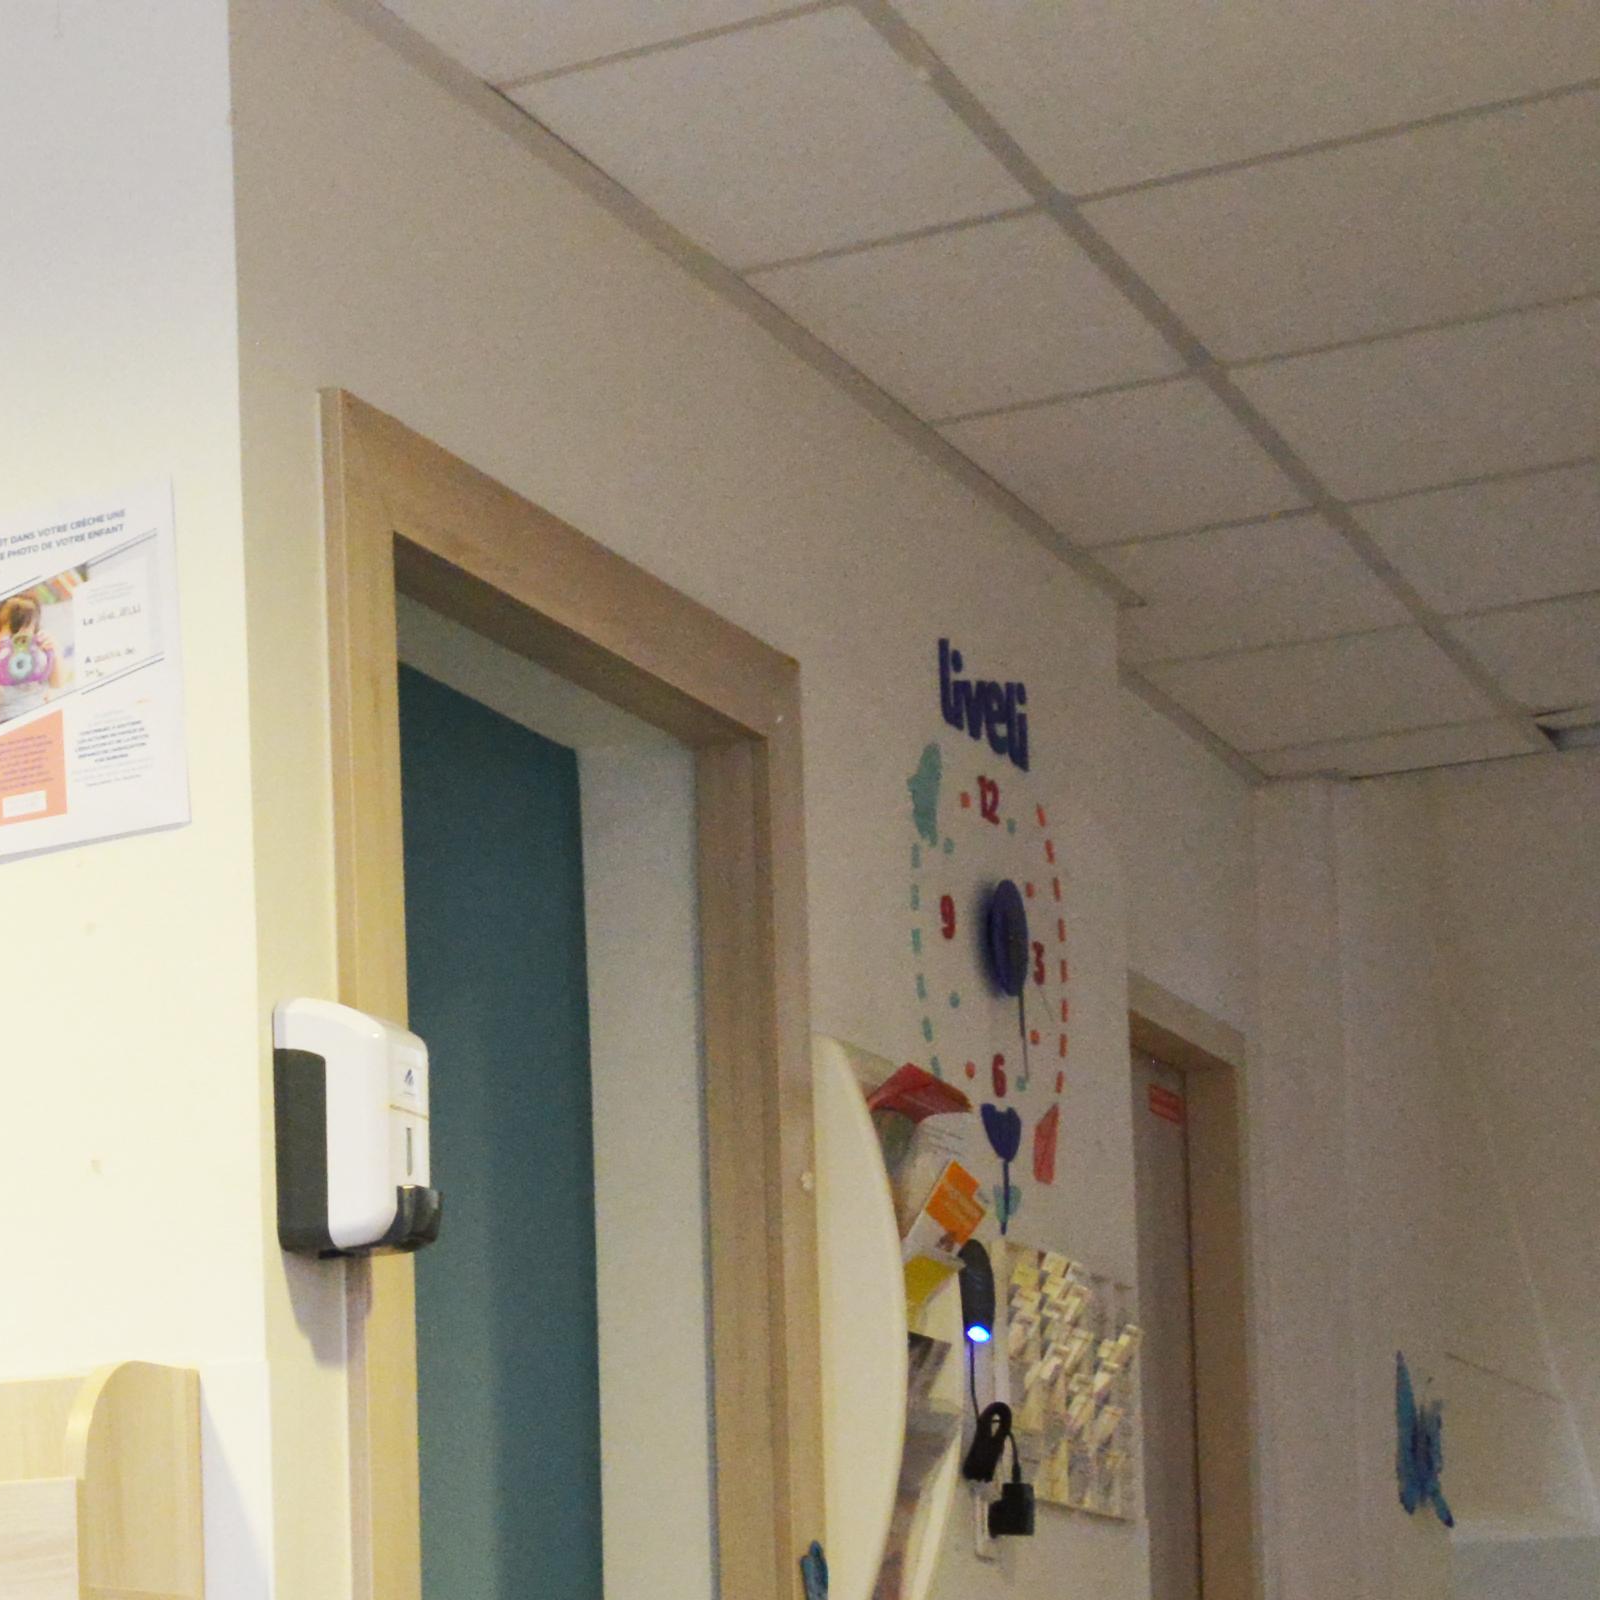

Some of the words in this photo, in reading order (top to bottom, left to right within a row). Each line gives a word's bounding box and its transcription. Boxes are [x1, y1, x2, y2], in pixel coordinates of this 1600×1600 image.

[7, 544, 39, 559] PHOTO
[41, 541, 53, 551] DE
[56, 534, 86, 547] VOTRE
[87, 523, 125, 540] ENFANT
[10, 531, 35, 545] DANS
[38, 523, 68, 537] VOTRE
